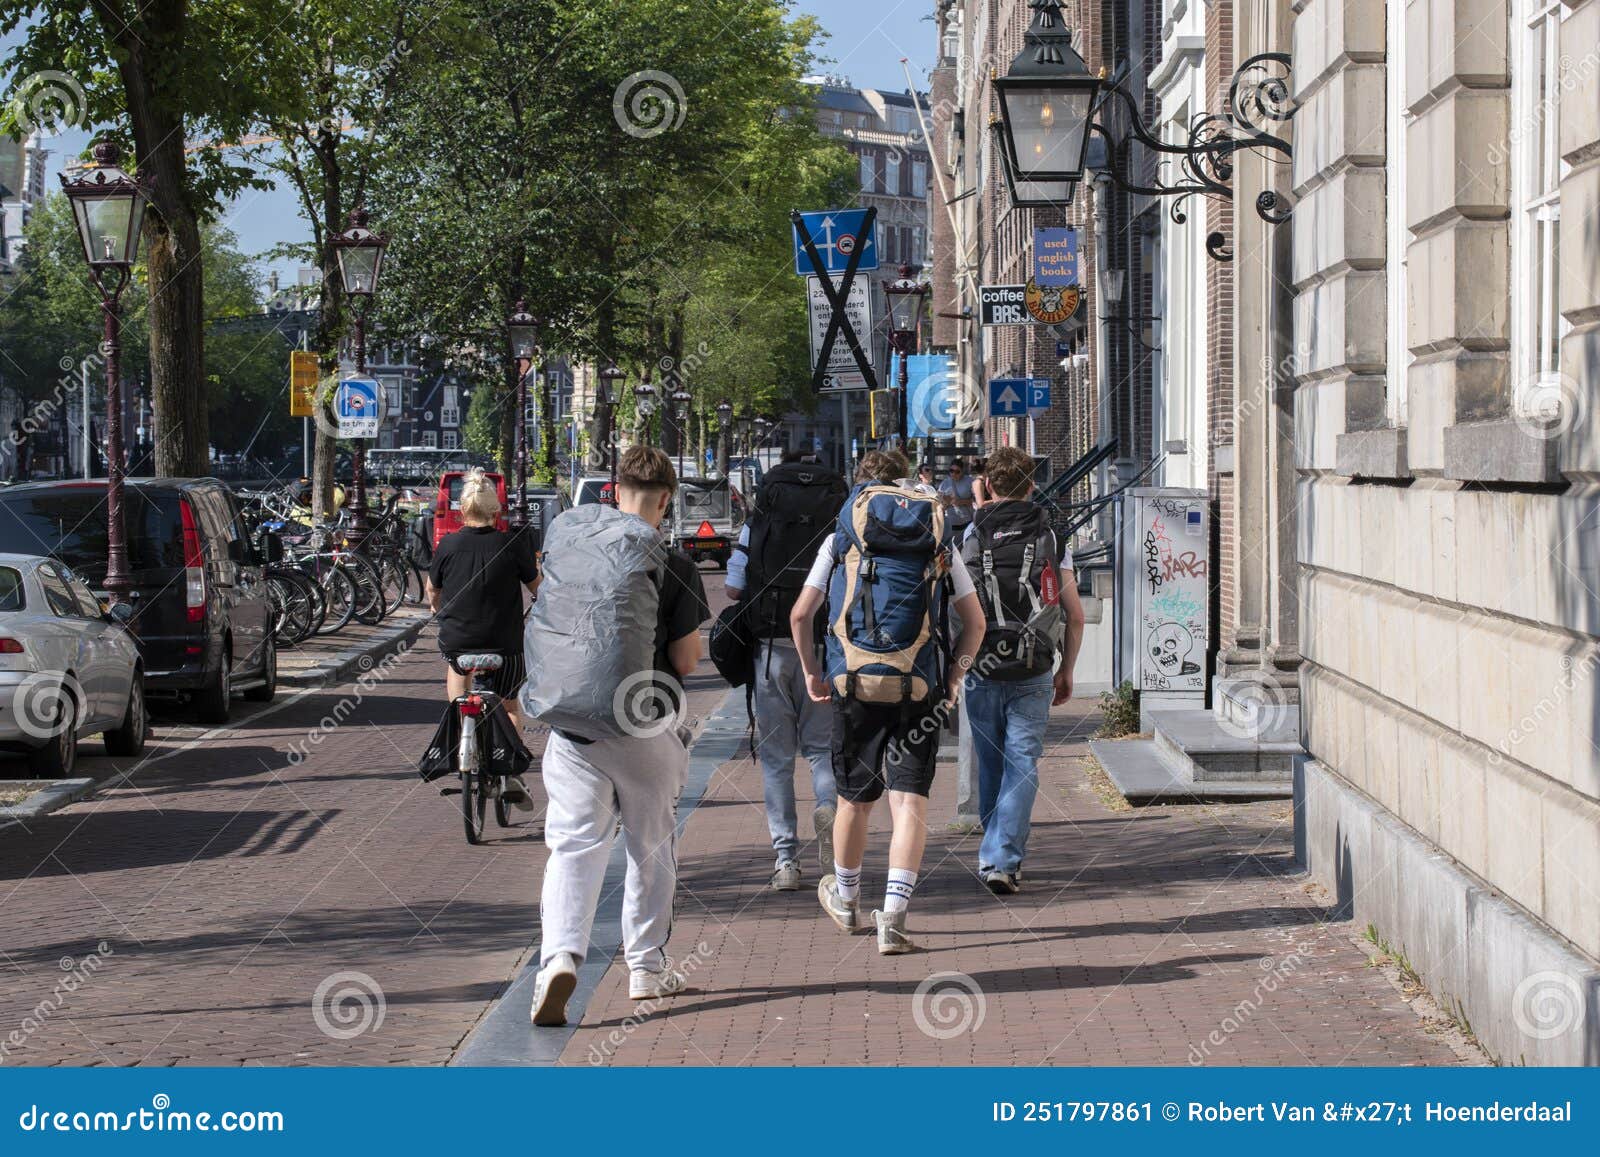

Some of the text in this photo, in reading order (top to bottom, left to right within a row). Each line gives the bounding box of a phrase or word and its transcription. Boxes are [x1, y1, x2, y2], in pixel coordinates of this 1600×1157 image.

[1044, 238, 1067, 248] used
[1038, 251, 1074, 264] english
[1041, 266, 1072, 276] books
[982, 289, 1024, 302] coffee
[1034, 390, 1044, 405] P
